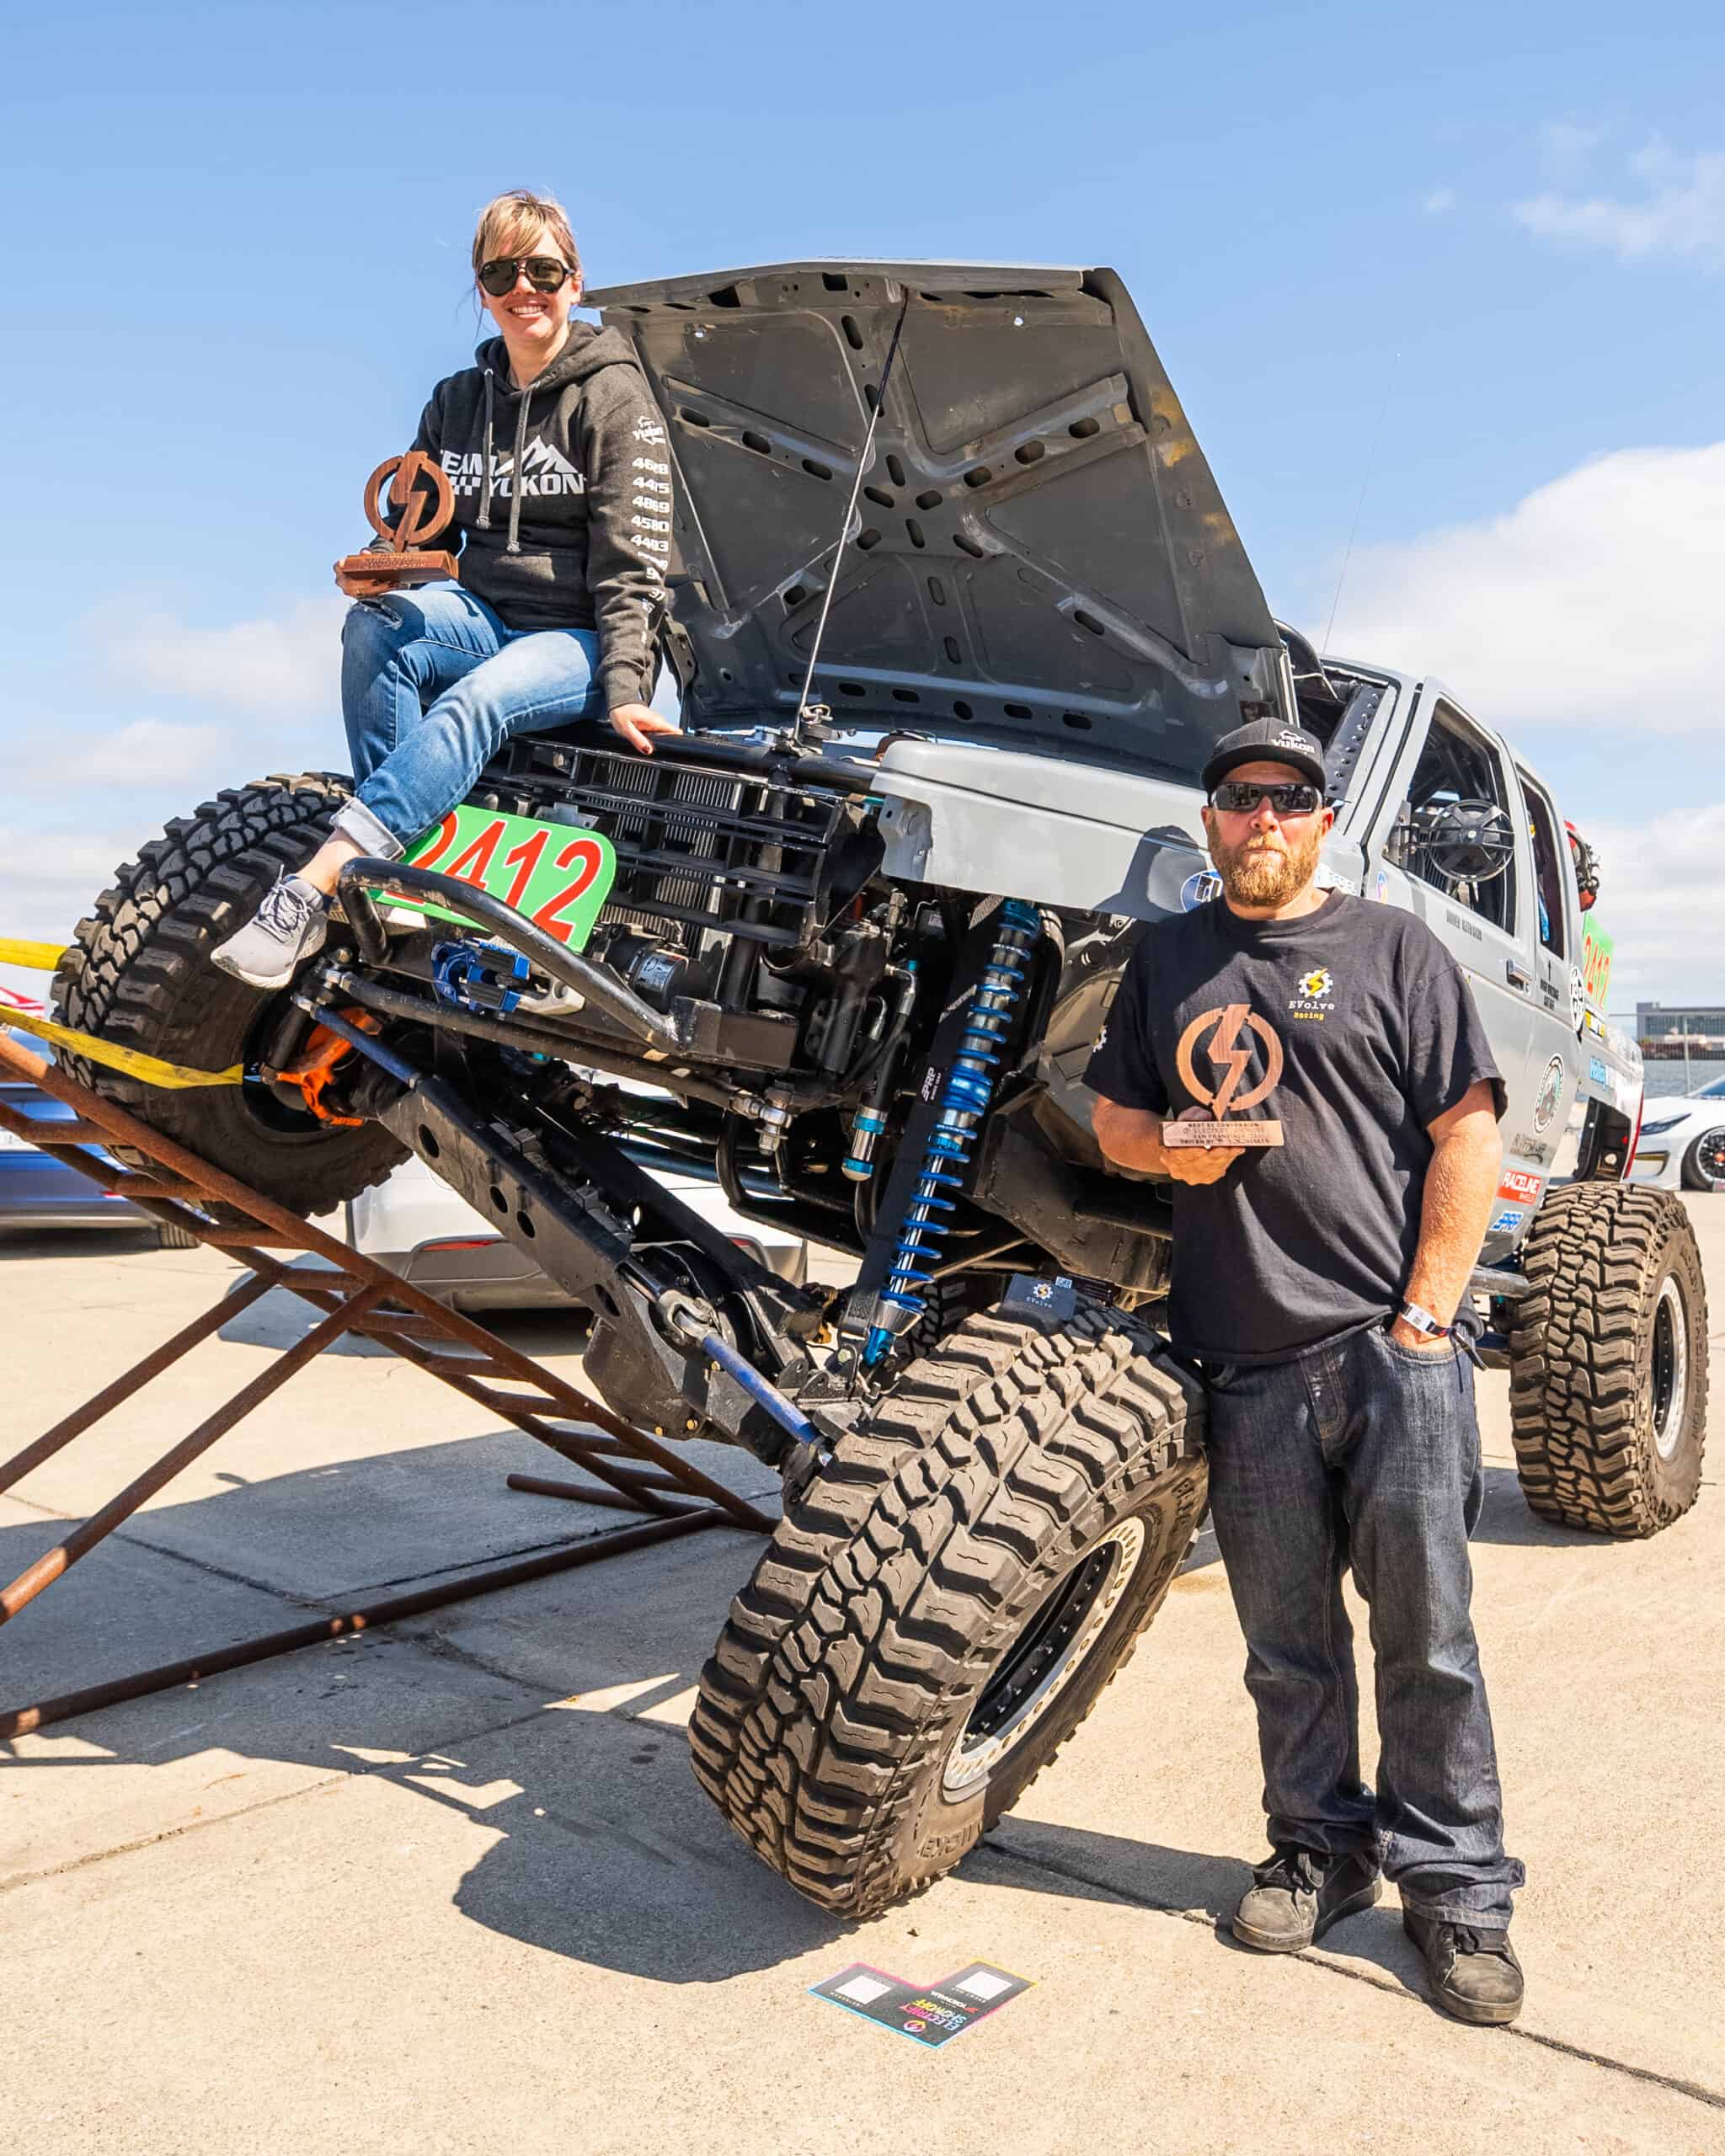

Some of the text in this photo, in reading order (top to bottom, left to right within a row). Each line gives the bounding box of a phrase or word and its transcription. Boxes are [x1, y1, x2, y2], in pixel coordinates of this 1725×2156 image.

[441, 450, 499, 477] EAM
[488, 472, 585, 498] YUKON
[1287, 1000, 1335, 1011] EVolve
[1293, 1011, 1325, 1022] Racing
